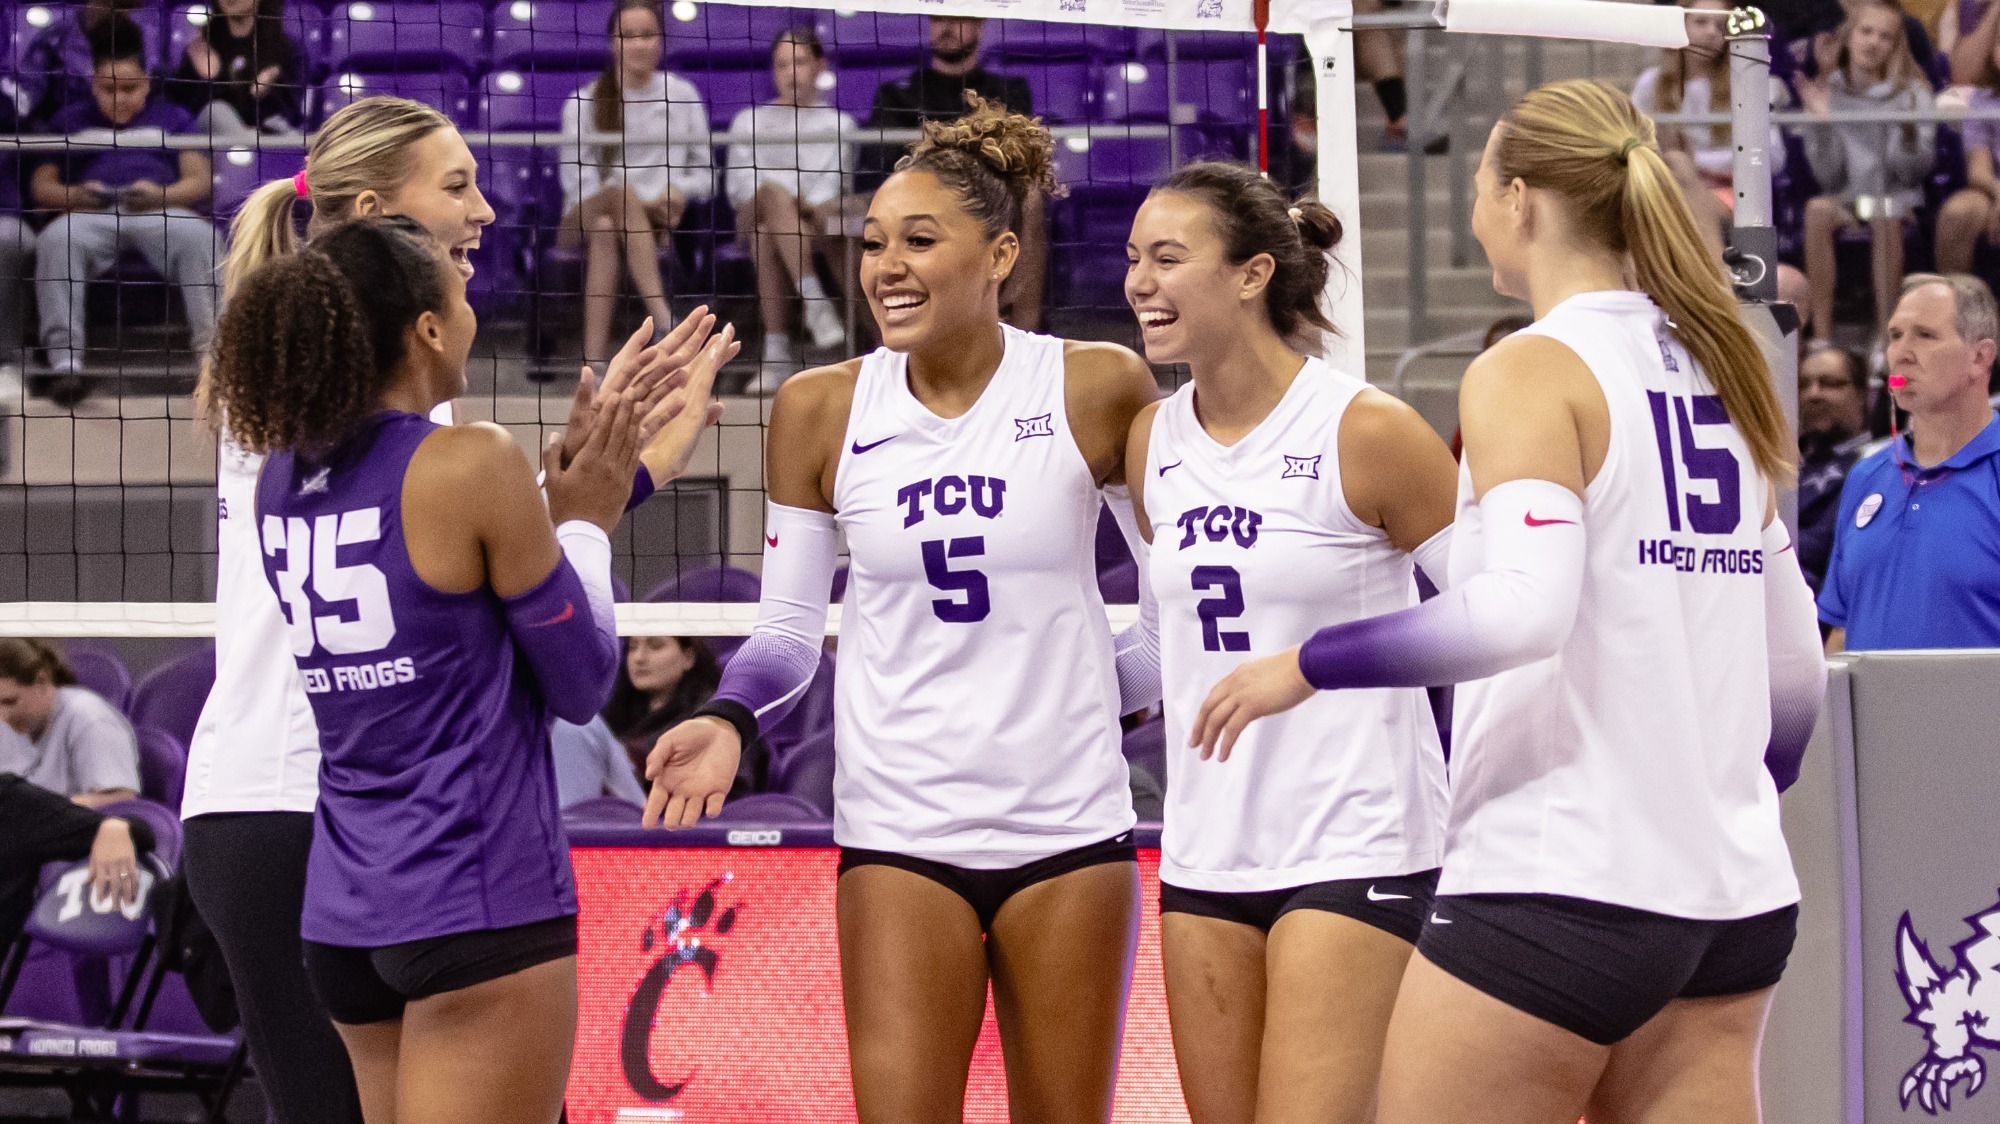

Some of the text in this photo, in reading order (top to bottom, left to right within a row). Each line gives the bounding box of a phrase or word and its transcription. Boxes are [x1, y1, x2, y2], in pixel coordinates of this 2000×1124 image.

[1646, 388, 1742, 535] 15
[897, 474, 1007, 530] TCU
[1176, 504, 1263, 551] TCU
[262, 506, 397, 658] 35
[920, 535, 991, 624] 5
[1701, 548, 1763, 574] FROGS
[1190, 565, 1252, 652] 2
[332, 656, 417, 692] FROGS
